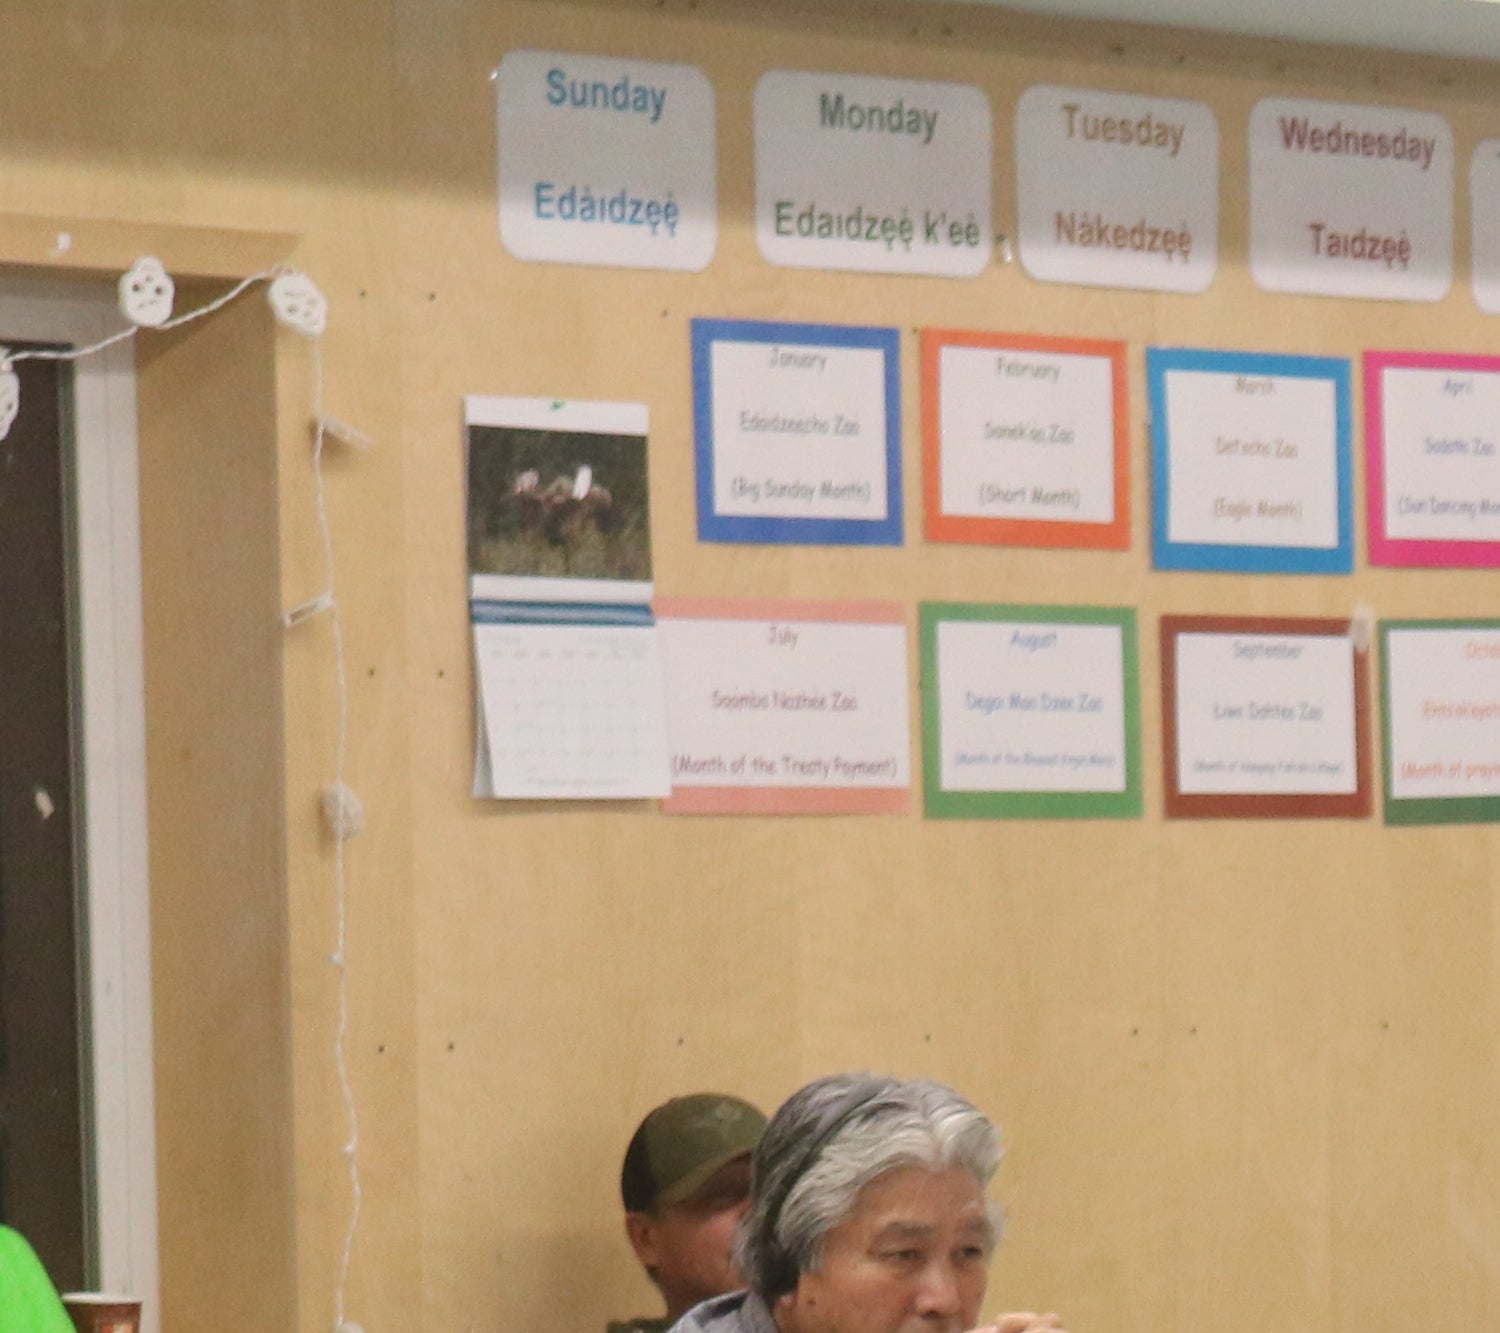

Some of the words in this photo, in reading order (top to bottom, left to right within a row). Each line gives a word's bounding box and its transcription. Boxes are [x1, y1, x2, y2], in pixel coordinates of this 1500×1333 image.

[545, 67, 668, 121] Sunday
[819, 92, 938, 145] Monday
[1062, 105, 1186, 156] Tuesday
[1280, 116, 1436, 171] Wednesday
[769, 346, 826, 372] January
[997, 356, 1061, 384] February
[765, 478, 816, 503] Sunday
[768, 625, 799, 649] July
